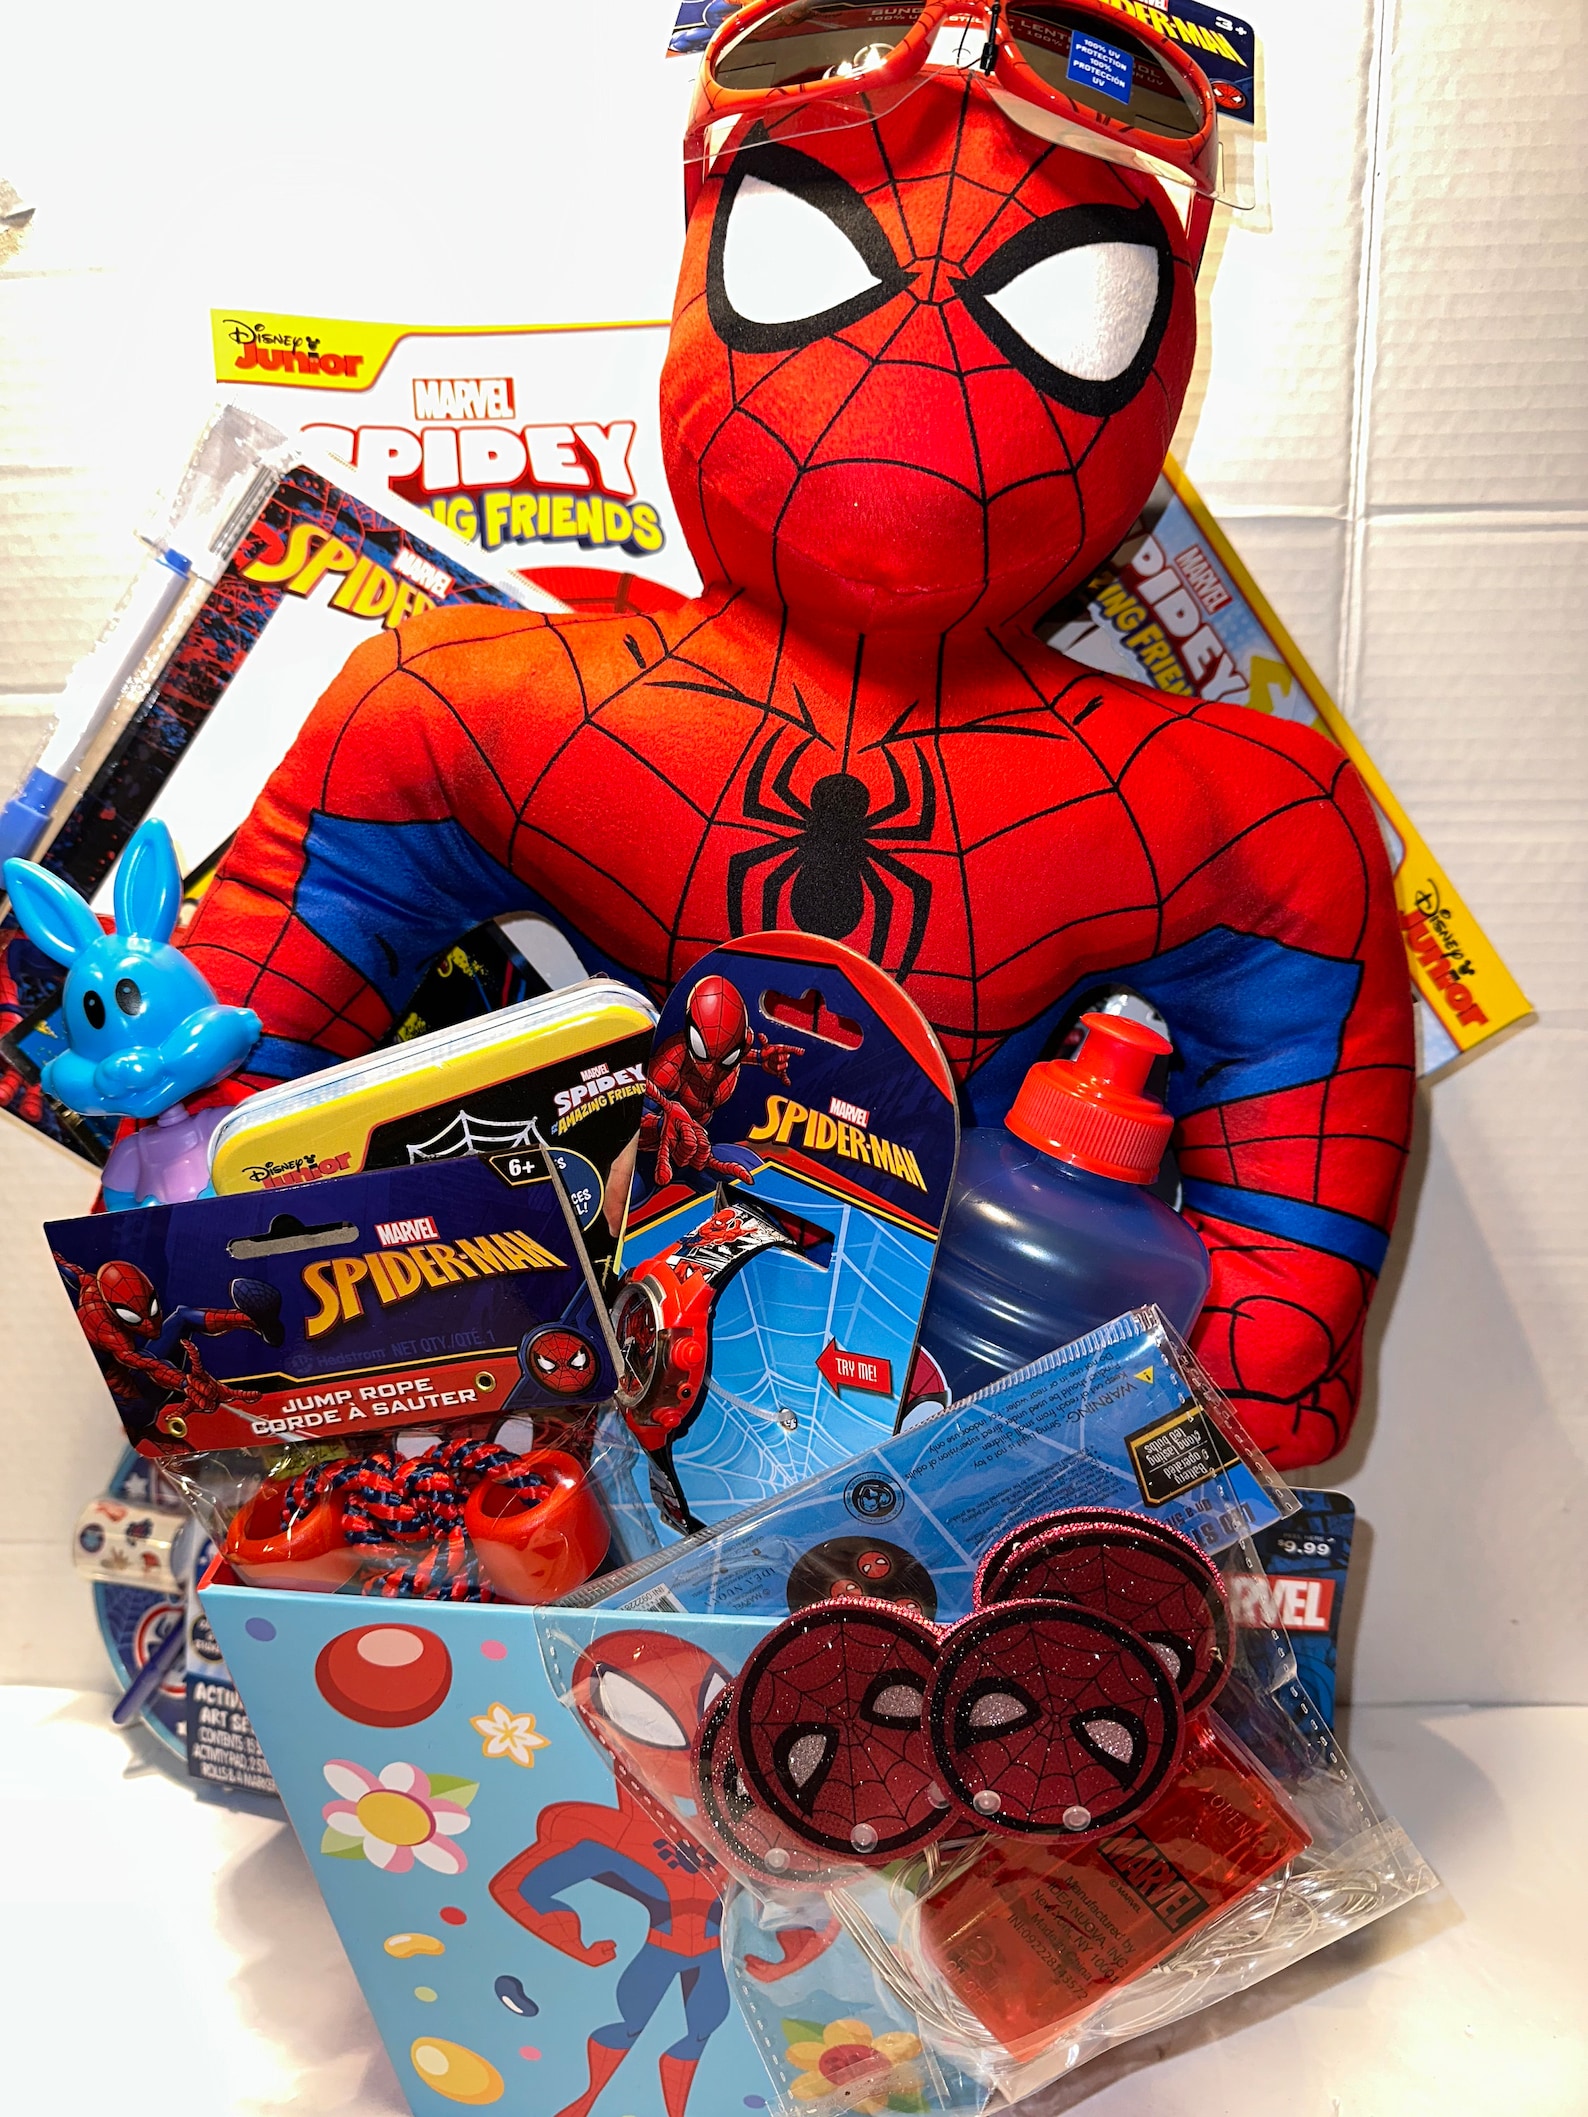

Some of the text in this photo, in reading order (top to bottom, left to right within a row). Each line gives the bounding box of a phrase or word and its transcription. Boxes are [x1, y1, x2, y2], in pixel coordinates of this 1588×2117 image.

[1021, 19, 1071, 43] LENT
[1215, 16, 1247, 36] 3+
[1075, 44, 1127, 71] PROTECTION
[1084, 39, 1120, 59] 100% UV
[1073, 60, 1125, 88] PROTECCIÓN
[1090, 58, 1112, 72] 100%
[1092, 77, 1105, 87] UV
[415, 379, 513, 419] MARVEL
[484, 493, 664, 552] FRIENDS
[393, 548, 453, 599] MARVEL
[1176, 546, 1231, 614] MARVEL
[1131, 535, 1248, 701] PIDEY
[580, 1063, 609, 1081] MARVEL
[554, 1063, 646, 1116] SPIDEY
[558, 1095, 607, 1136] AMAZING
[607, 1083, 647, 1106] FRIEND
[829, 1098, 869, 1128] MARVEL
[748, 1094, 927, 1193] SPIDER-MAN
[509, 1158, 534, 1177] 6+
[376, 1218, 438, 1246] MARVEL
[302, 1230, 570, 1340] SPIDER-MAN
[391, 1340, 417, 1357] NET
[835, 1357, 877, 1382] TRY ME!
[1058, 1375, 1068, 1385] in
[282, 1378, 433, 1414] JUMP ROPE
[1028, 1385, 1048, 1400] near
[1049, 1380, 1058, 1389] or
[1060, 1377, 1088, 1398] should
[1028, 1398, 1049, 1415] used
[1048, 1392, 1061, 1404] be
[1055, 1395, 1080, 1414] reach
[251, 1388, 477, 1435] CORDE À SAUTER
[1004, 1409, 1028, 1427] under
[1035, 1408, 1057, 1425] from
[960, 1418, 987, 1437] indoor
[980, 1422, 1004, 1441] direct
[1013, 1418, 1036, 1436] small
[937, 1432, 981, 1462] supervision
[993, 1447, 1007, 1458] not
[1143, 1427, 1185, 1454] led bulbs
[926, 1458, 938, 1470] of
[1145, 1445, 1179, 1466] lasting
[1162, 1451, 1201, 1479] operated
[1173, 1462, 1207, 1485] Battery
[1278, 1539, 1331, 1556] $9.99
[1230, 1576, 1325, 1627] RVEL
[1100, 1828, 1201, 1929] MARVEL
[1046, 1881, 1074, 1909] IDEA
[1116, 1886, 1142, 1913] MARVEL
[1030, 1888, 1056, 1915] New
[1072, 1934, 1092, 1954] NY
[1063, 1876, 1136, 1955] Manufactured by
[1029, 1913, 1056, 1941] Made
[1064, 1950, 1094, 1981] China
